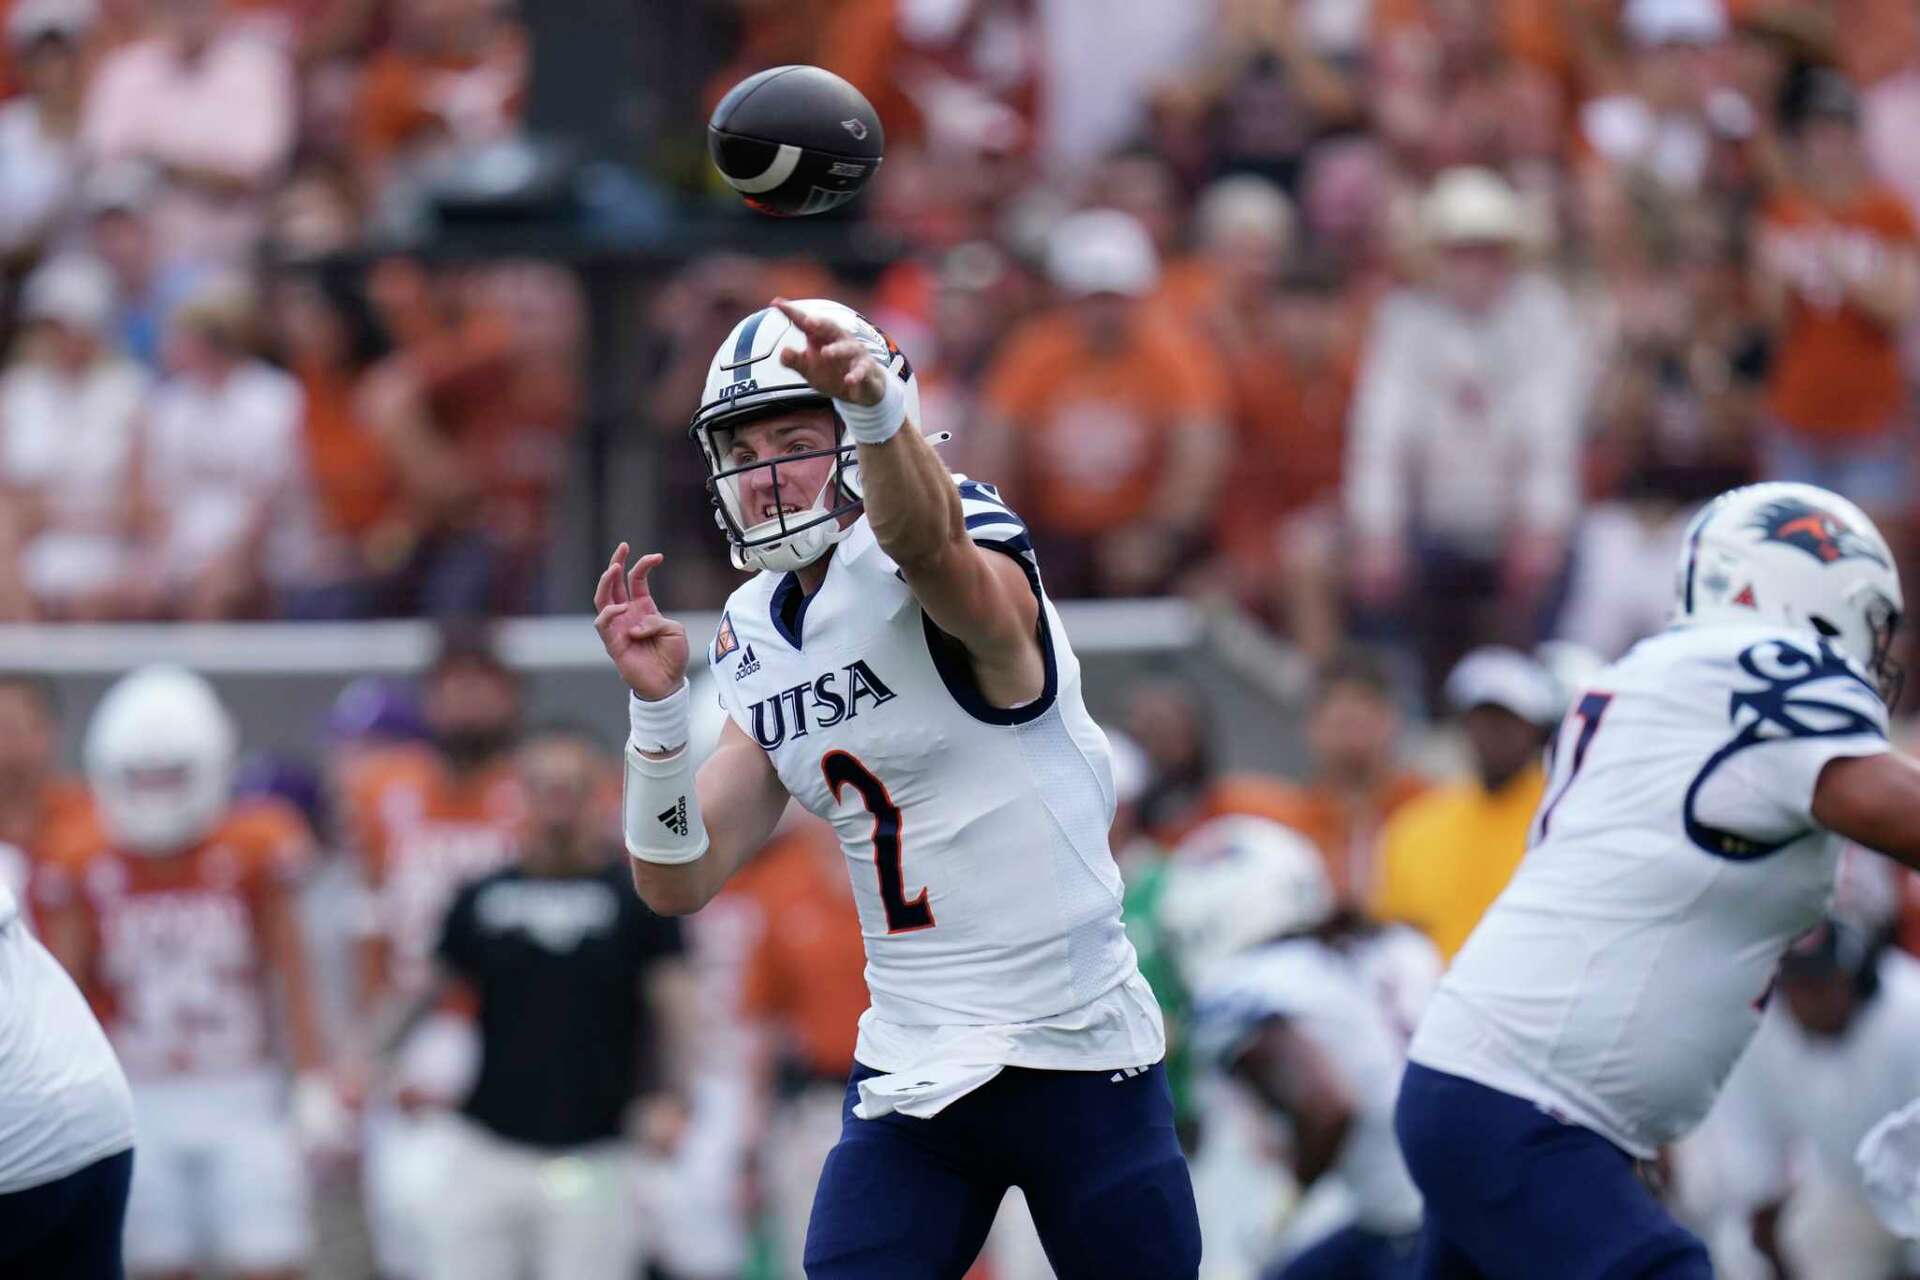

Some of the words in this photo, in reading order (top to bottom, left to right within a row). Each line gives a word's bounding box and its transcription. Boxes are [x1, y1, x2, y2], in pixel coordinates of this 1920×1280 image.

[719, 378, 759, 399] UTSA
[735, 661, 761, 682] adidas
[748, 658, 898, 752] UTSA
[677, 795, 689, 837] adidas
[820, 748, 937, 936] 2
